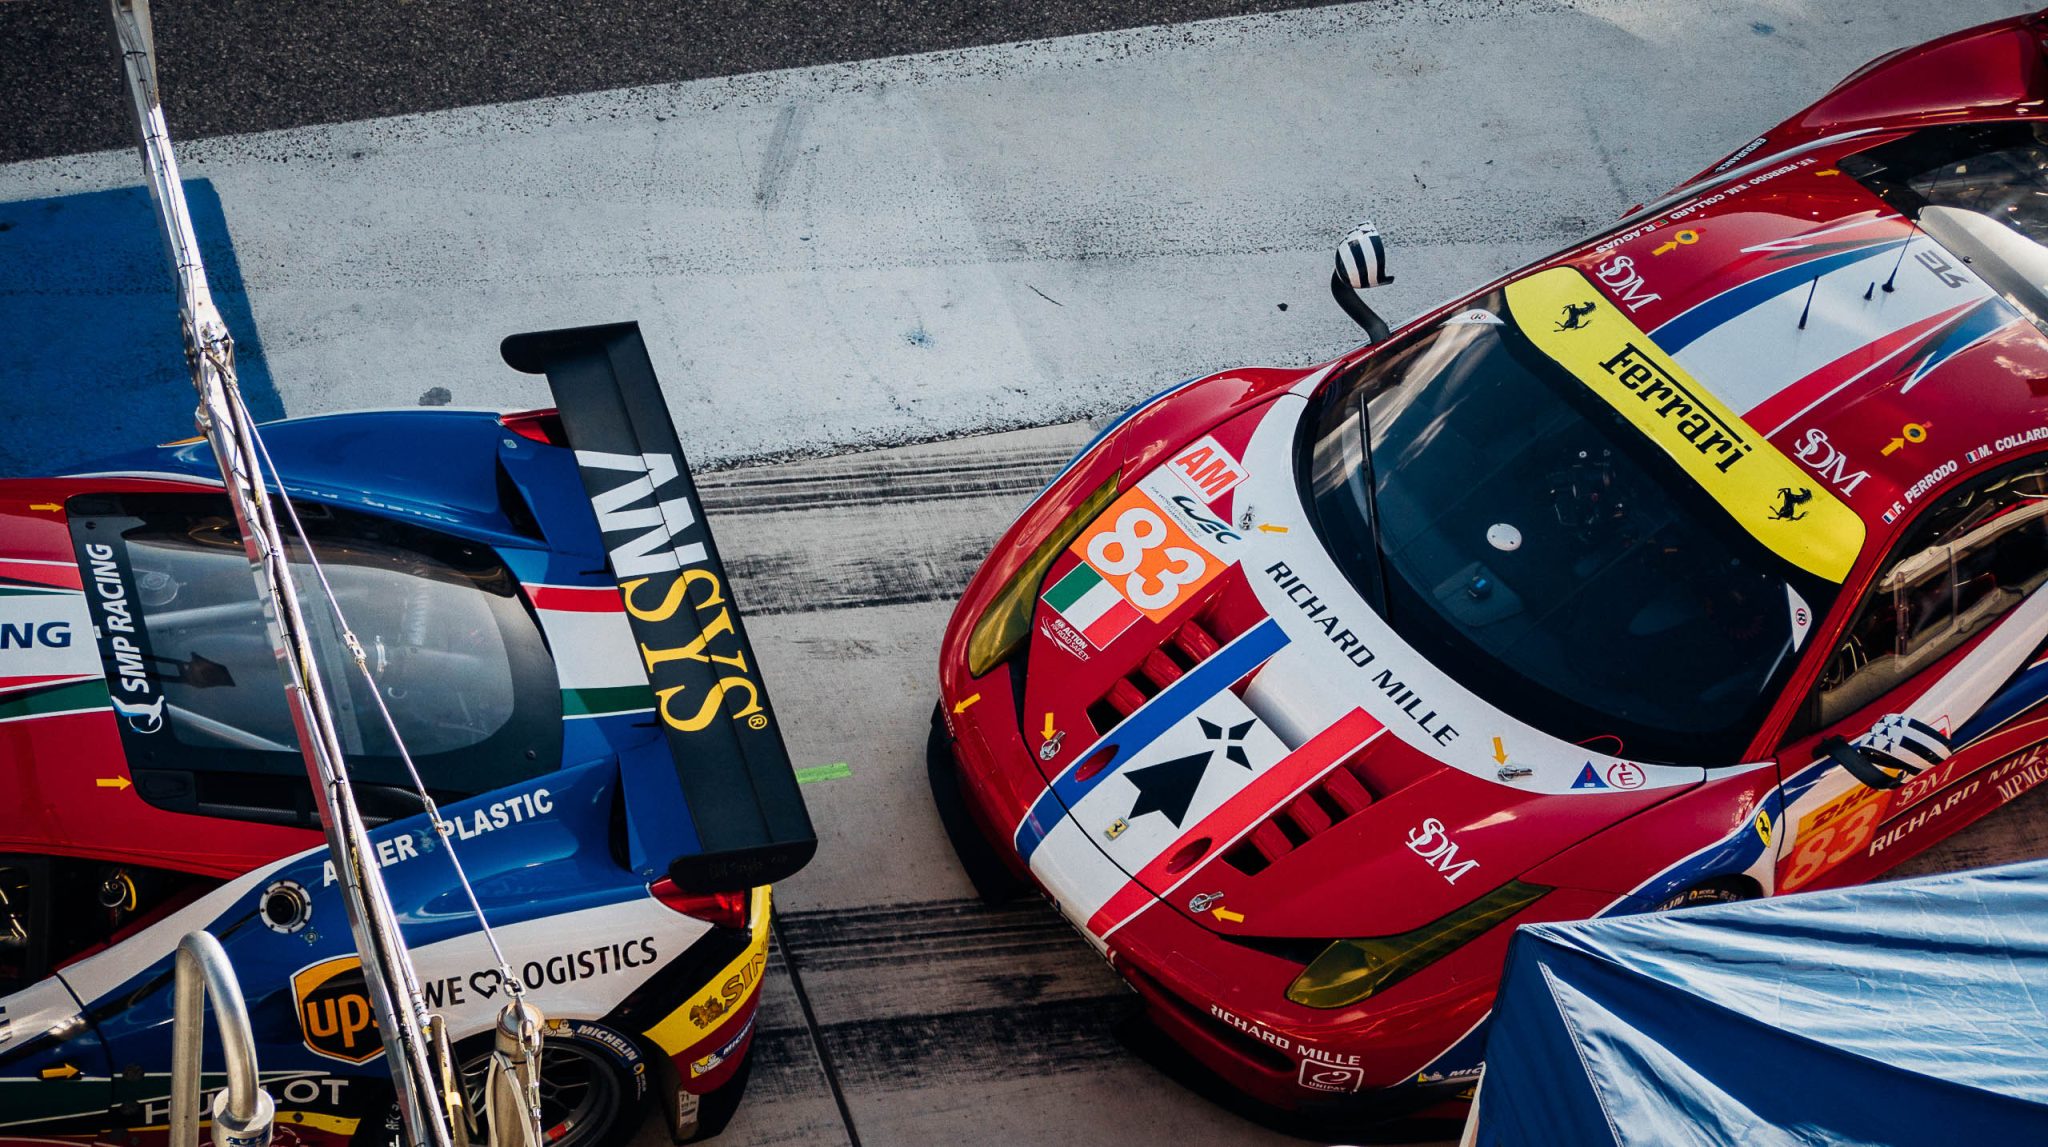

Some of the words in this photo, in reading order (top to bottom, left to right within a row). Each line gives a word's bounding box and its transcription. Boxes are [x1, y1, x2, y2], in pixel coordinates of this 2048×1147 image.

[1670, 194, 1726, 220] COLLARD
[1595, 229, 1641, 254] AGUAS
[1595, 255, 1662, 313] SDM
[1598, 342, 1753, 474] Ferrari
[1175, 446, 1239, 497] AM
[1792, 428, 1871, 498] SDM
[1978, 445, 1993, 459] M.
[1892, 501, 1905, 516] F.
[1904, 460, 1958, 504] PERRODO
[1172, 496, 1242, 544] WEC
[1086, 507, 1206, 610] 83
[85, 543, 135, 633] RACING
[112, 636, 150, 693] SMP
[1063, 626, 1088, 649] ACTION
[1266, 561, 1377, 667] RICHARD
[1371, 669, 1460, 747] MILLE
[1782, 803, 1878, 890] 83
[1869, 780, 1981, 857] RICHARD
[1405, 817, 1480, 886] SDM
[523, 936, 658, 989] OGISTICS
[577, 1025, 638, 1061] MICHELIN
[1211, 1004, 1290, 1049] RICHARD
[1297, 1045, 1361, 1066] MILLE
